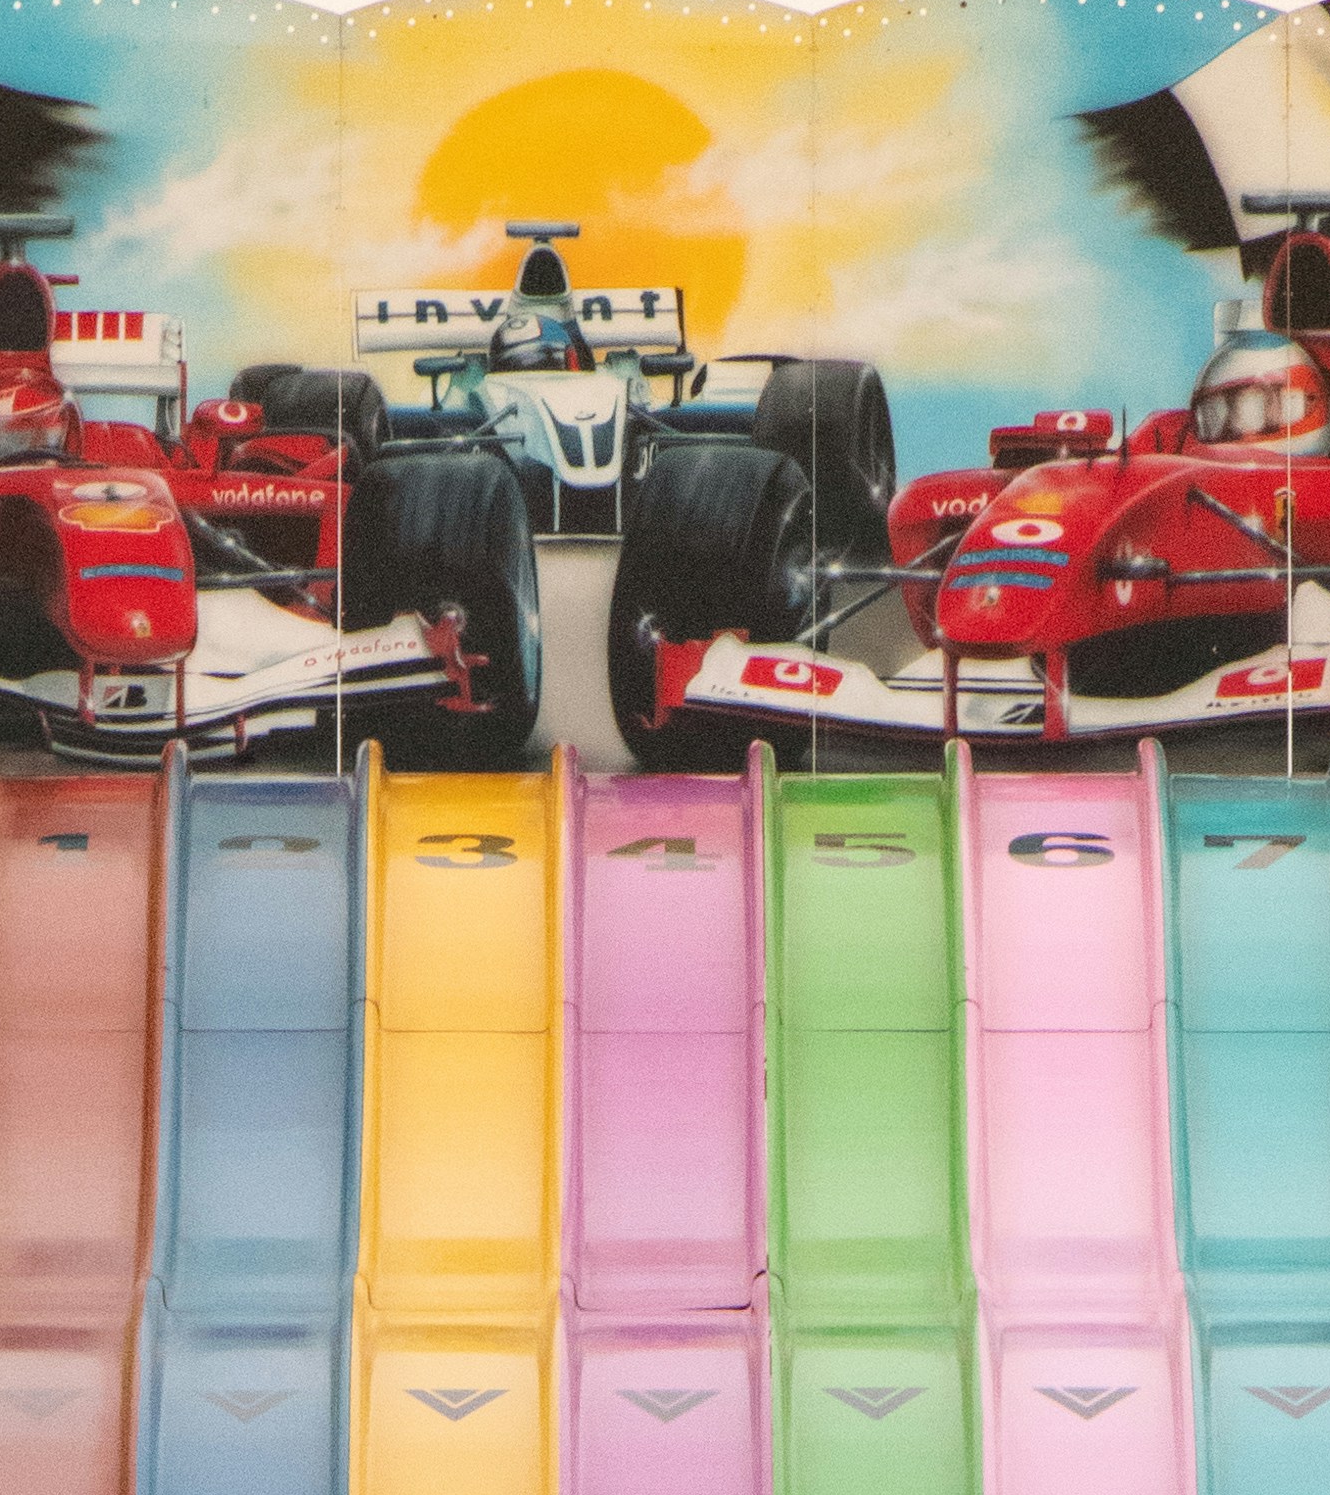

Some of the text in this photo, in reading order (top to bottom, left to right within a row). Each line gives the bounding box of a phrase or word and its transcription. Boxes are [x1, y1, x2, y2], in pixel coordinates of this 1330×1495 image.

[378, 291, 661, 324] invnt
[212, 482, 326, 505] vodafone
[415, 834, 518, 869] 3
[606, 836, 721, 872] 4
[812, 833, 917, 868] 5
[1008, 832, 1115, 868] 6
[1203, 834, 1307, 870] 7
